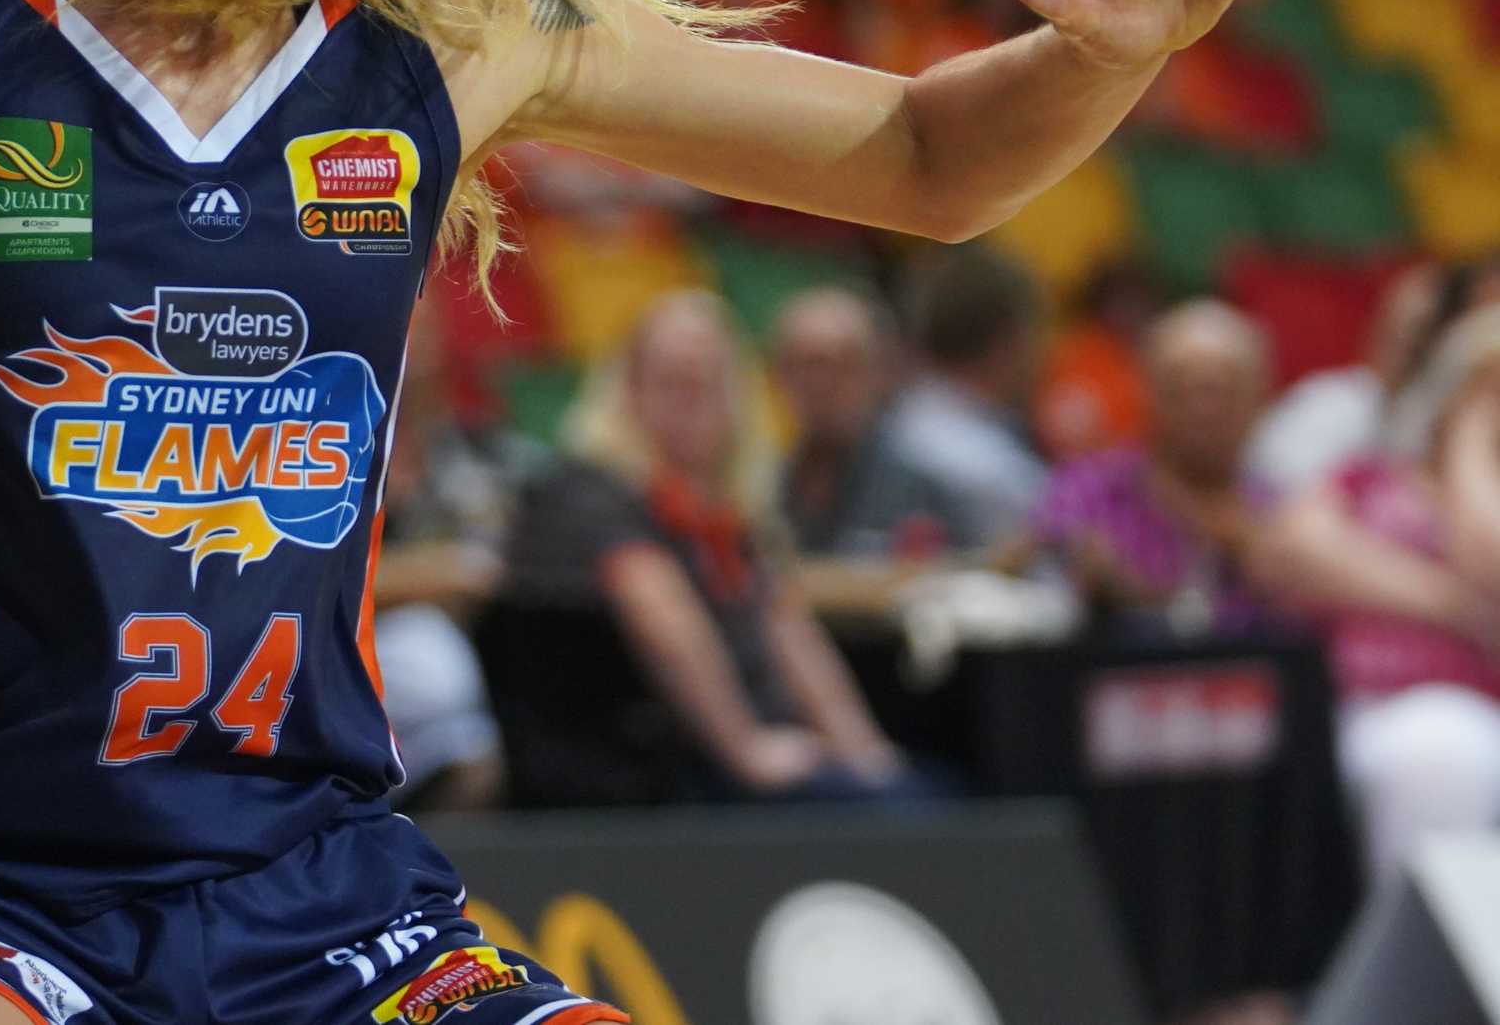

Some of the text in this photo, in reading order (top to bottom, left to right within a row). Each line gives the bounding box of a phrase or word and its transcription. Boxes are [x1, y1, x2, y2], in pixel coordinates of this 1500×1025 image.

[317, 158, 397, 178] CHEMIST
[322, 181, 392, 191] WAREHOUSE
[331, 209, 405, 233] WNBL
[5, 247, 74, 256] CAMPERDOWN
[9, 238, 70, 247] APARTMENTS
[165, 304, 293, 342] brydens
[211, 340, 289, 362] lawyers
[118, 385, 317, 414] SYDNEY UNI
[48, 420, 350, 494] FLAMES
[98, 612, 302, 766] 24
